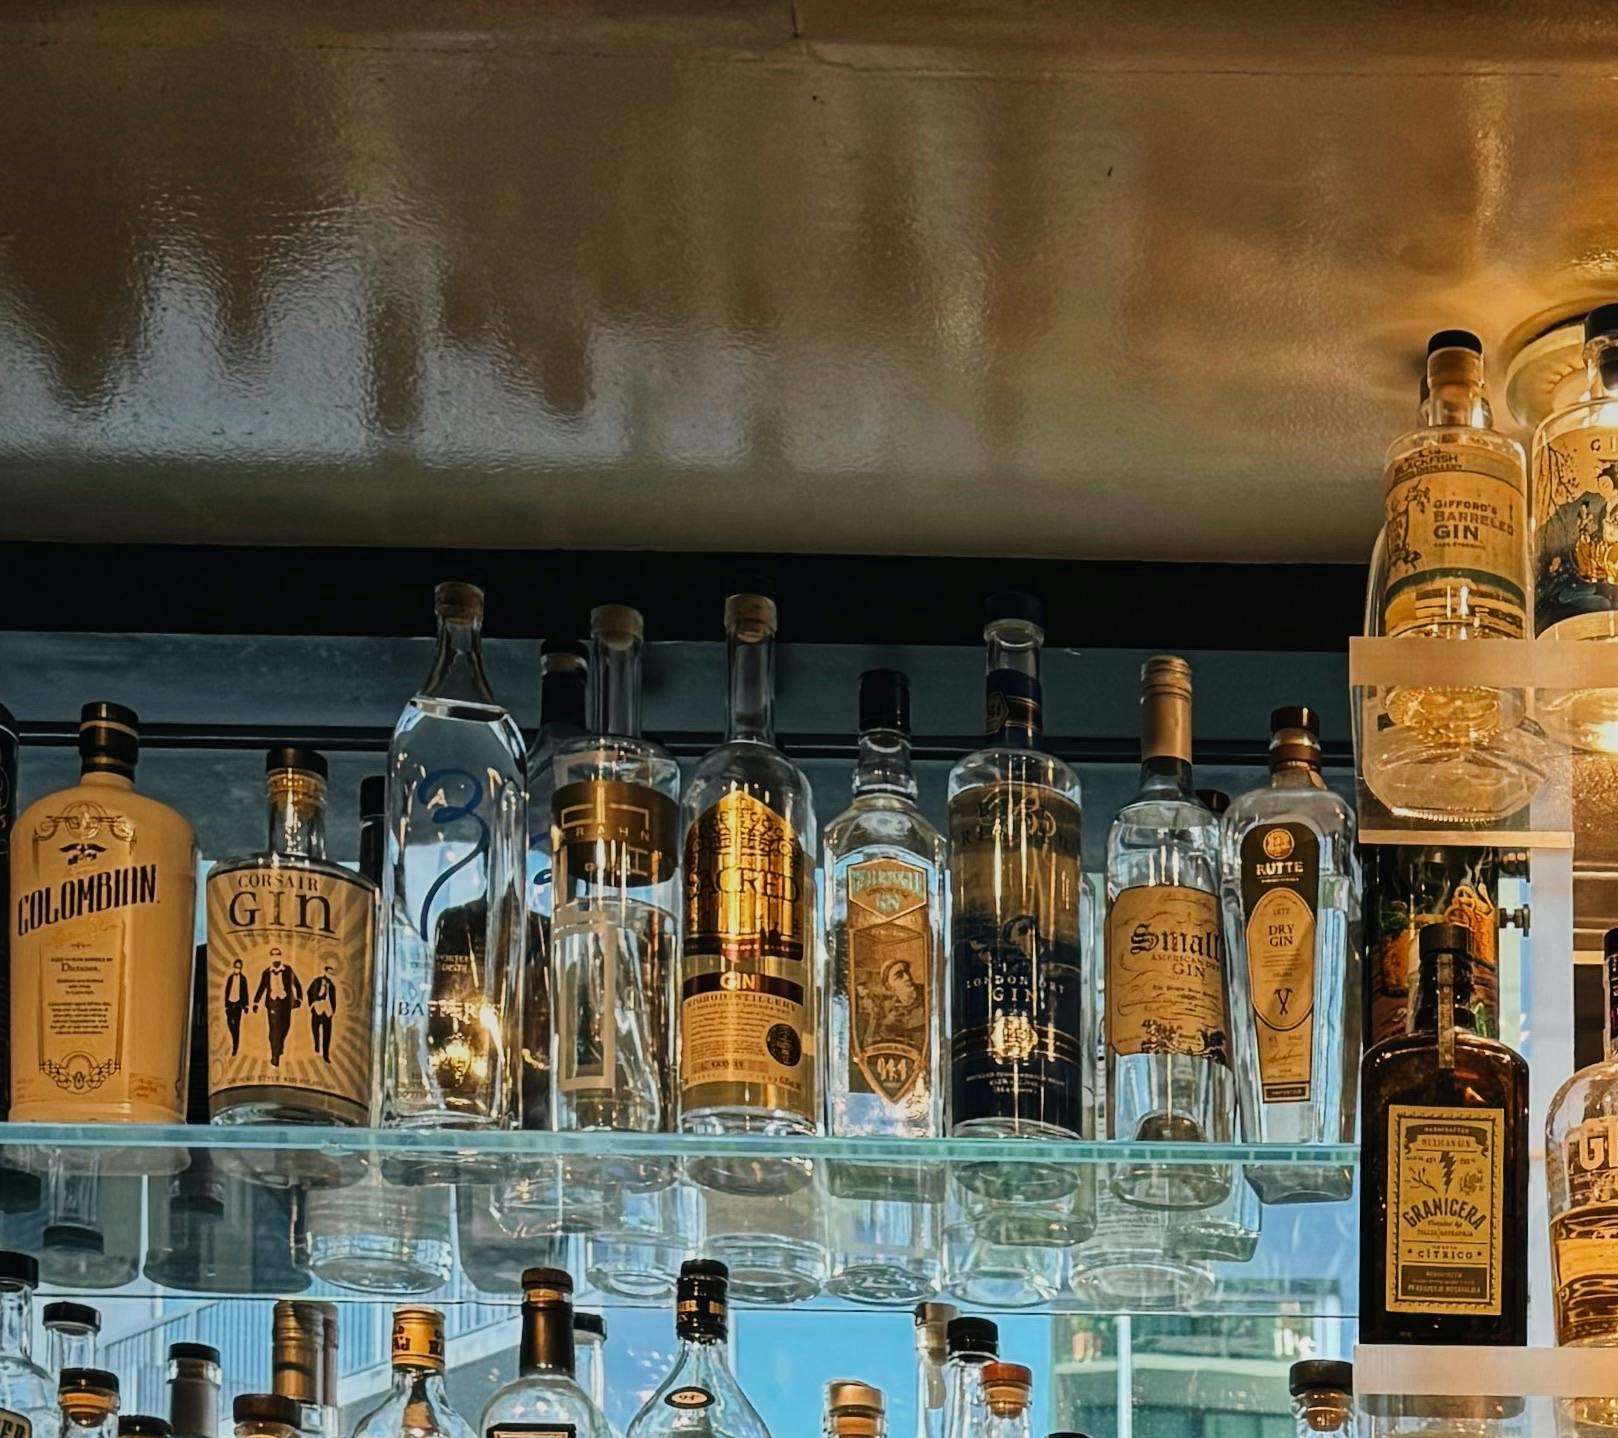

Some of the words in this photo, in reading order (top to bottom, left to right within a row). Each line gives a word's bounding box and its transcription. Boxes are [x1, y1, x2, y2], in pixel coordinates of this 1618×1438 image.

[1433, 511, 1513, 535] BARRELED
[1433, 525, 1479, 540] GIN
[1257, 861, 1304, 876] RUTTE
[239, 872, 317, 890] CORSAIR
[18, 865, 158, 936] COLOMBIAN
[1269, 924, 1294, 936] DRY
[1130, 922, 1222, 962] Small
[1269, 936, 1293, 947] GIN
[1172, 963, 1206, 979] GIN
[720, 972, 756, 990] GIN
[1402, 1198, 1487, 1229] GRANICERA
